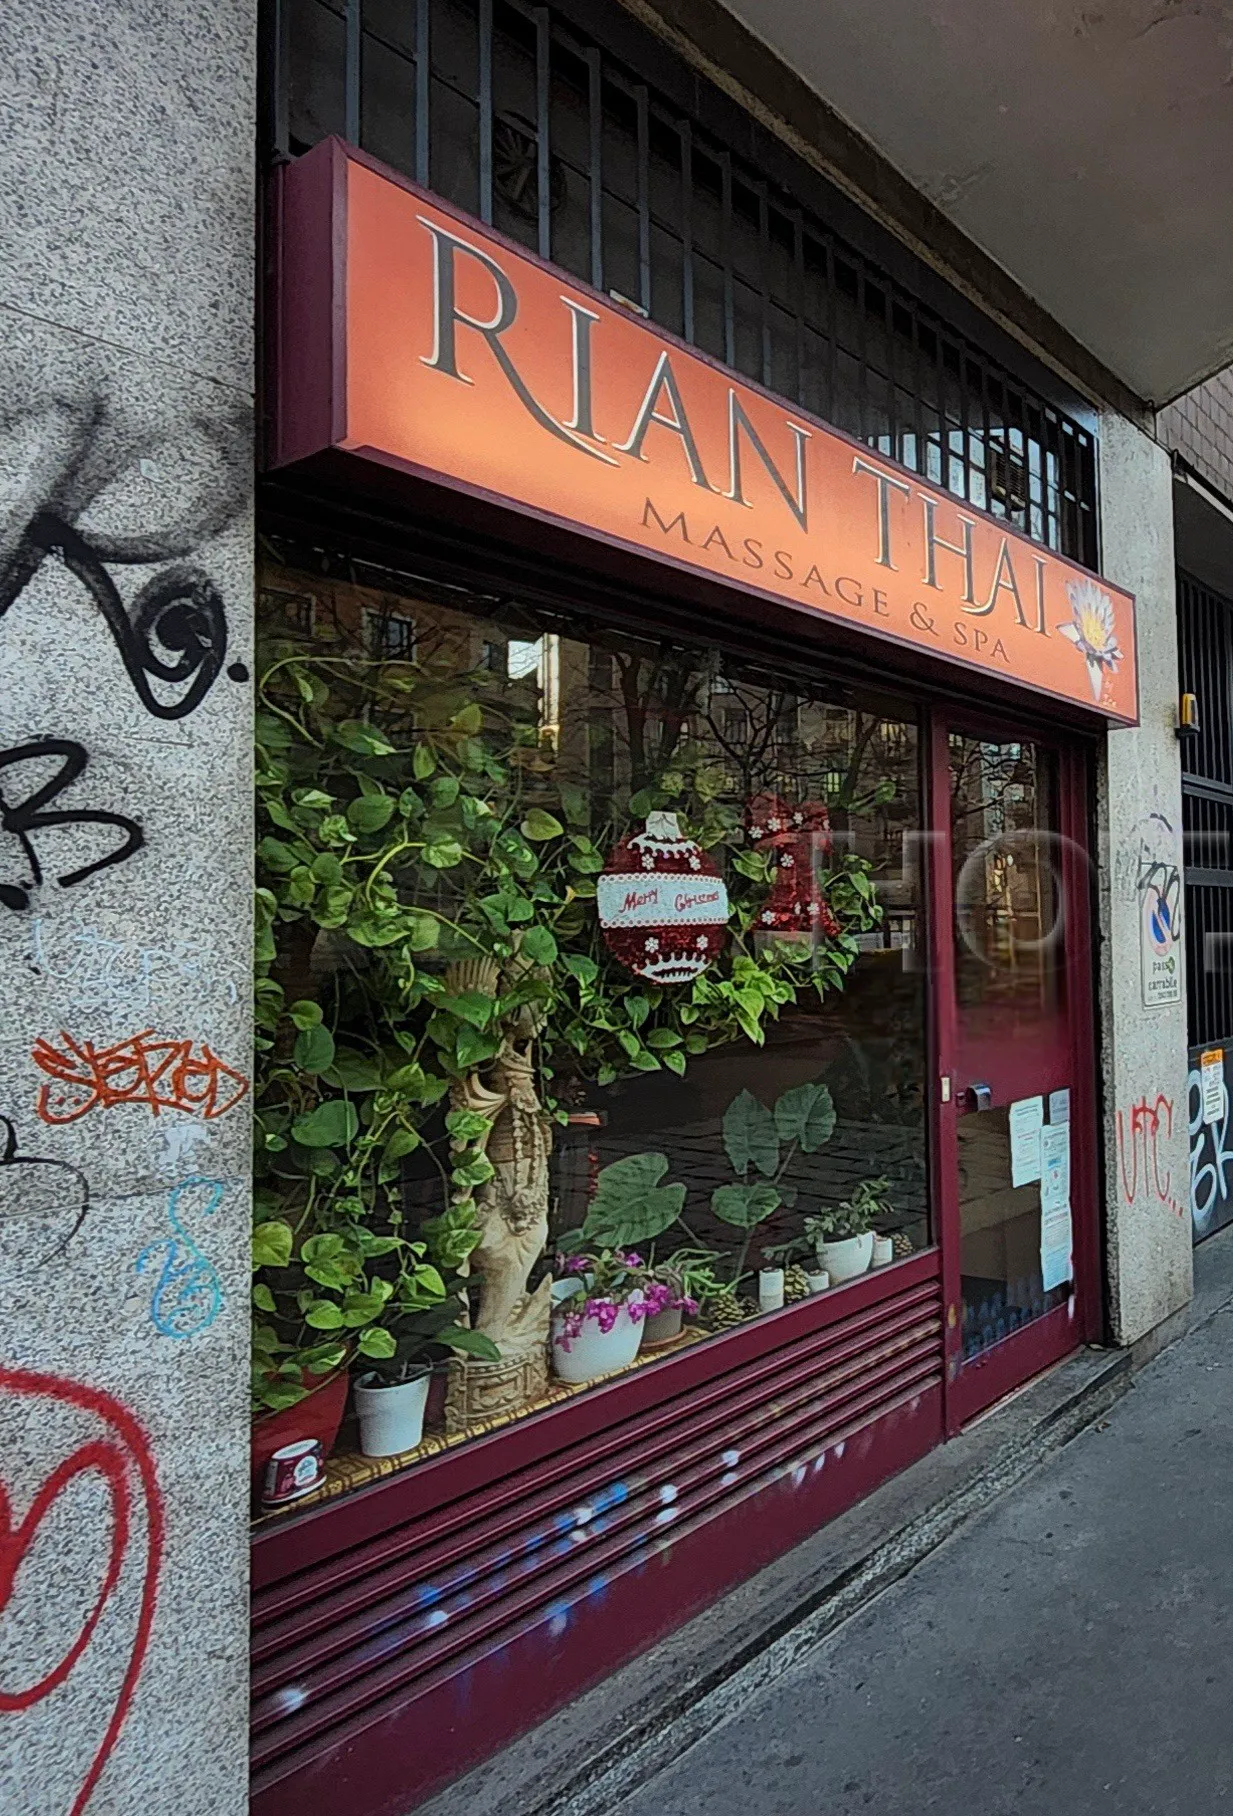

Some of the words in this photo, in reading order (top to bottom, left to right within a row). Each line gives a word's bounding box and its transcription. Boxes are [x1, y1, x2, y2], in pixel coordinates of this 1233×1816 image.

[415, 214, 812, 535] RIAN
[852, 456, 1052, 639] THAI
[641, 496, 892, 618] MASSAGE
[909, 601, 941, 637] &
[952, 621, 1012, 664] SPA
[618, 887, 658, 914] Merry
